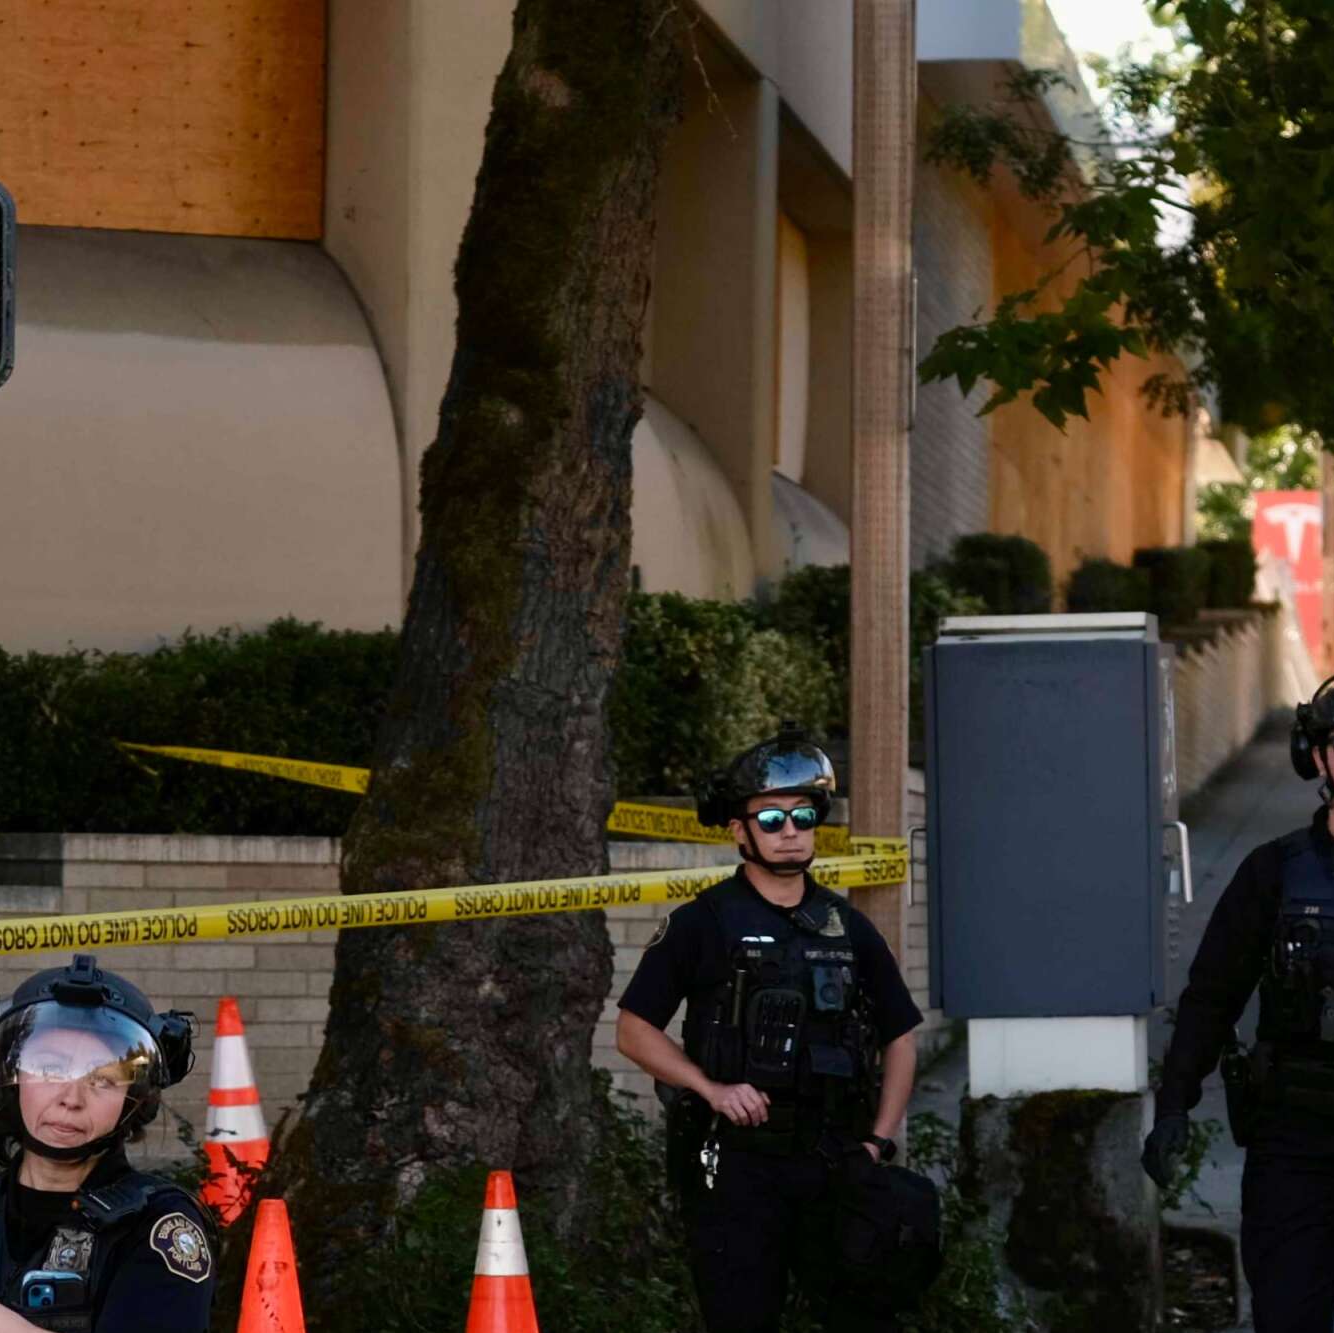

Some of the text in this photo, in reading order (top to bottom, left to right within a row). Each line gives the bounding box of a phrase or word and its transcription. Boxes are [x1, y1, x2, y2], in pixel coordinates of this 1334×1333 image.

[454, 881, 640, 916] POLICE LINE DO NOT CROSS
[142, 912, 198, 940] POLICE
[227, 896, 427, 933] POLICE LINE DO NOT CROSS
[40, 922, 73, 948] NOT
[78, 921, 101, 945] DO
[104, 918, 138, 943] LINE
